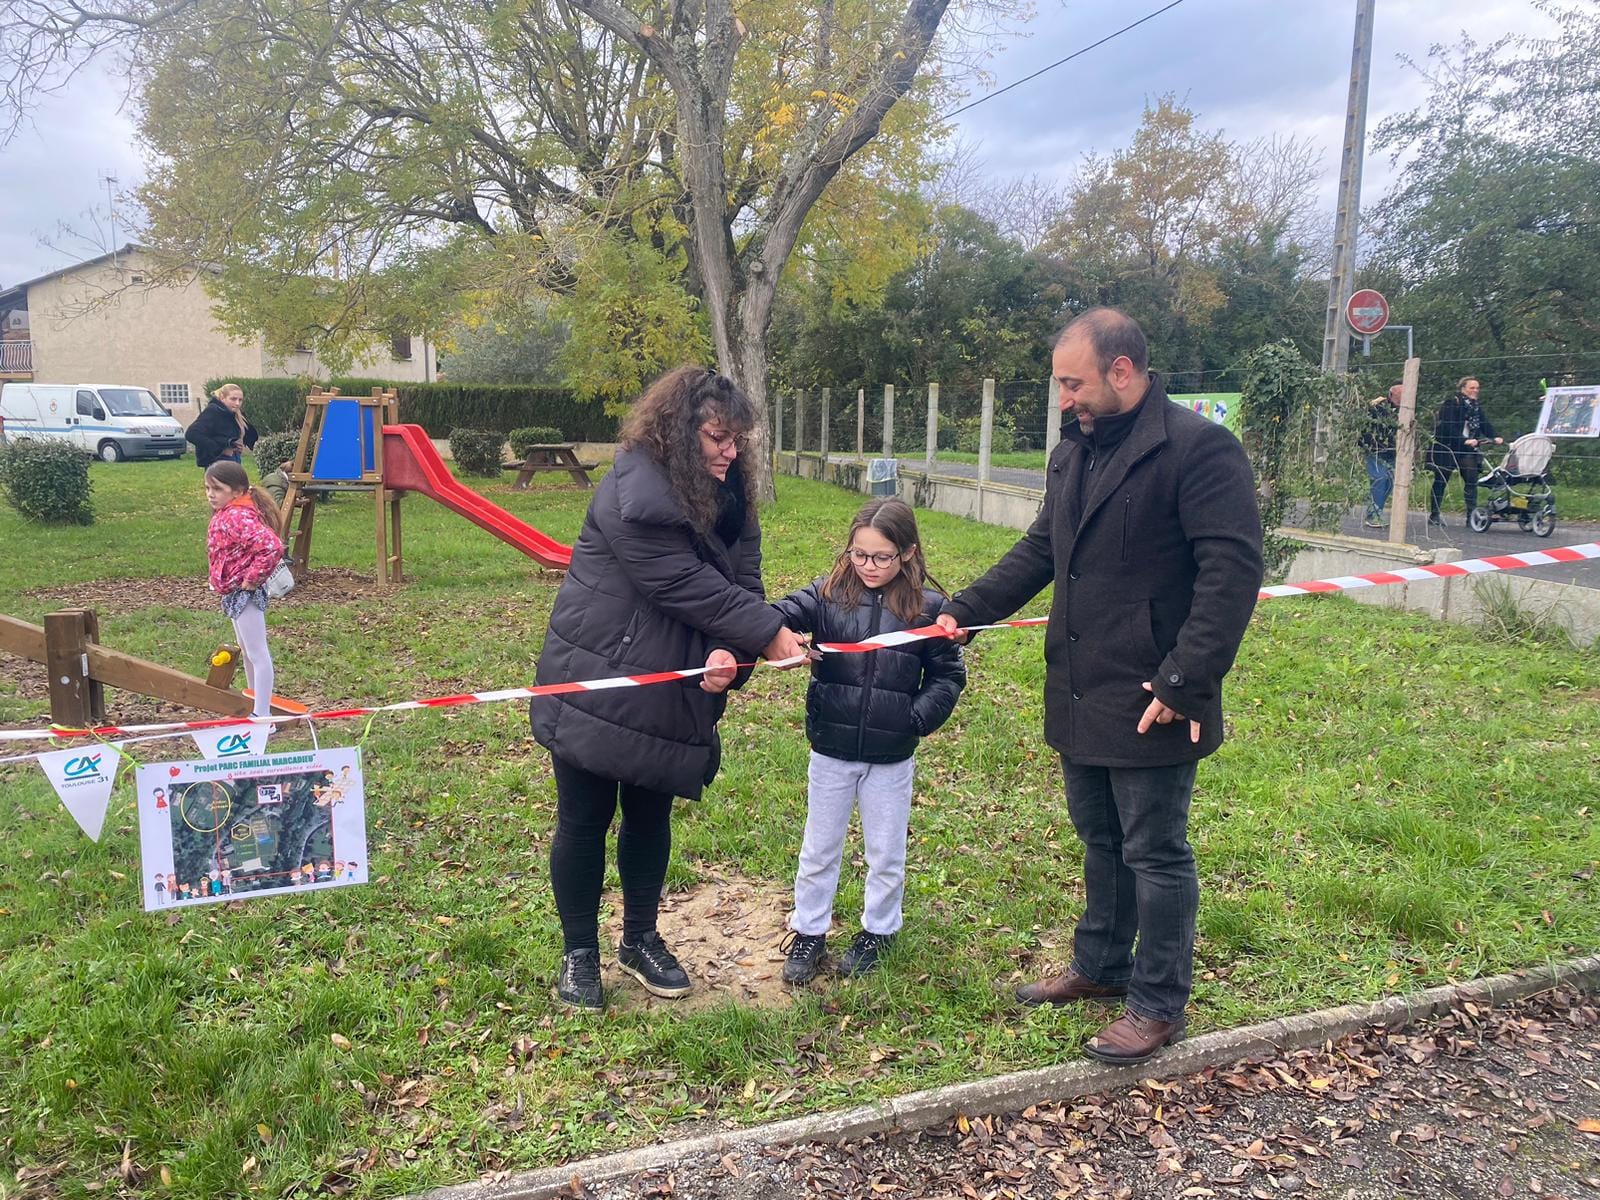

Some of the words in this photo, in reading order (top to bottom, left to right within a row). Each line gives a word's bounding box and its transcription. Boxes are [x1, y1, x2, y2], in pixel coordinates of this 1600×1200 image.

[194, 764, 218, 773] Projet
[219, 761, 238, 770] PARC
[239, 758, 271, 768] FAMILIAL
[61, 779, 96, 789] TOULOUSE
[97, 775, 109, 783] 31
